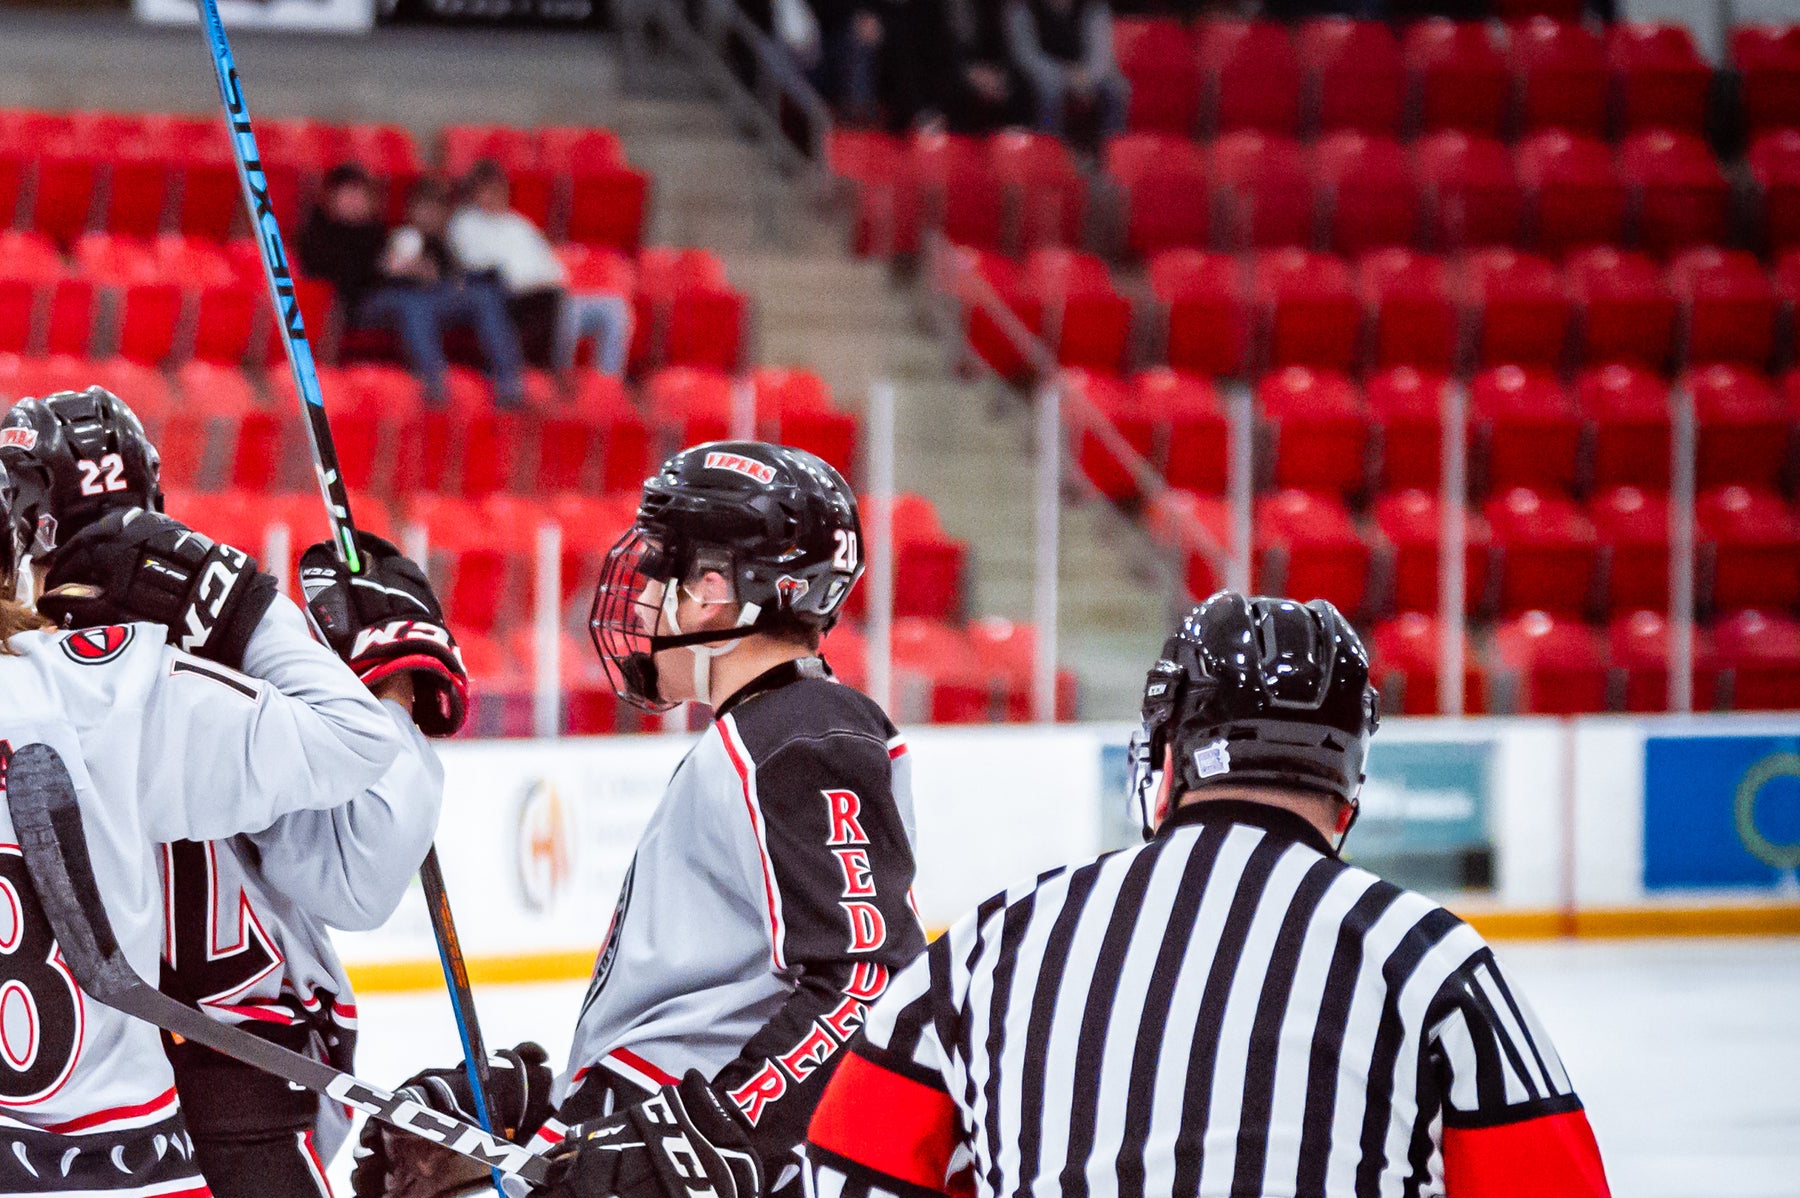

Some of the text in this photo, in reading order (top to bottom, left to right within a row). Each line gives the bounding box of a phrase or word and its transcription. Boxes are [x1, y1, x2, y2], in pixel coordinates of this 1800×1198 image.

[77, 453, 127, 496] 22
[705, 453, 776, 484] VIPERS
[833, 528, 858, 573] 20
[326, 1073, 536, 1175] CCM
